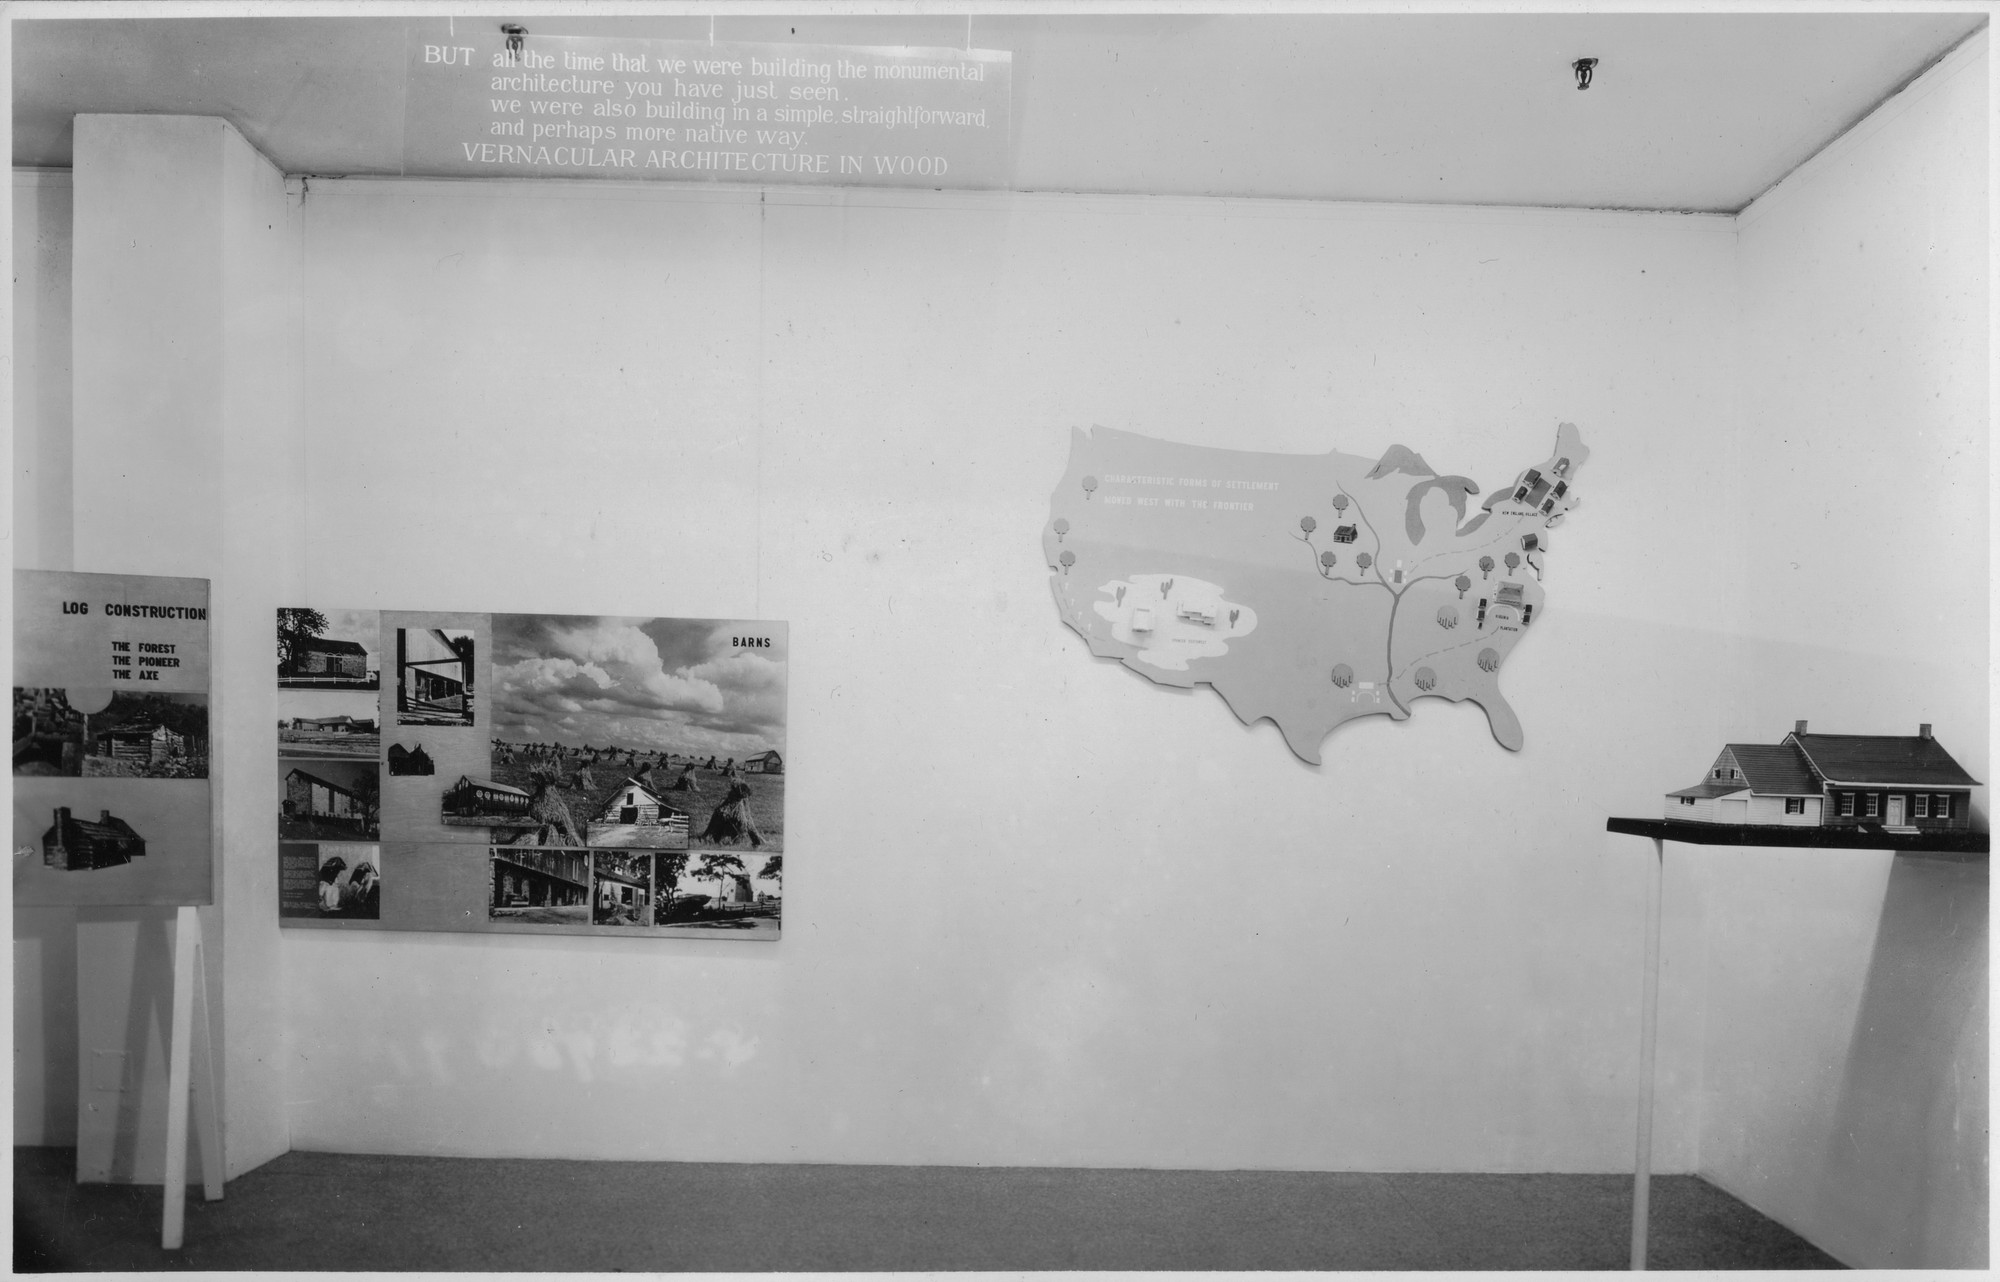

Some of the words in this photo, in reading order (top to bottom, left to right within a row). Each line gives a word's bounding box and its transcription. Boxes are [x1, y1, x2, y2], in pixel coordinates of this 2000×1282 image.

[424, 45, 475, 66] BUT
[492, 48, 516, 68] all
[523, 49, 555, 69] the
[564, 51, 605, 71] time
[612, 53, 650, 73] that
[657, 58, 687, 74] we
[692, 59, 743, 75] were
[751, 57, 831, 84] building
[837, 59, 867, 79] the
[874, 62, 984, 81] monumental
[491, 73, 615, 94] architecture
[625, 81, 662, 99] you
[674, 78, 723, 98] have
[732, 80, 778, 103] just
[789, 85, 849, 101] seen.
[491, 99, 521, 113] we
[530, 101, 583, 116] were
[593, 98, 637, 117] also
[646, 99, 726, 128] building
[733, 103, 750, 121] in
[756, 107, 768, 121] a
[774, 104, 839, 127] simple,
[841, 105, 990, 130] straightforward,
[491, 119, 524, 136] and
[533, 120, 617, 144] perhaps
[626, 126, 676, 142] more
[686, 125, 748, 143] native
[756, 129, 808, 151] way.
[462, 142, 638, 168] VERNACULAR
[645, 149, 830, 173] ARCHITECTURE
[840, 155, 863, 174] IN
[873, 155, 948, 176] WOOD
[1104, 474, 1175, 486] CHARACTERISTIC
[1179, 478, 1208, 488] FORMS
[1211, 480, 1222, 488] OF
[1225, 481, 1280, 491] SETTLEMENT
[1104, 495, 1132, 505] MOVED
[1137, 498, 1159, 507] WEST
[1164, 498, 1185, 508] WITH
[1191, 500, 1208, 509] THE
[1213, 501, 1254, 512] FRONTIER
[63, 601, 89, 615] LOG
[105, 603, 207, 620] CONSTRUCTION
[112, 641, 131, 652] THE
[138, 642, 176, 654] FOREST
[733, 636, 770, 647] BARNS
[112, 655, 131, 666] THE
[138, 657, 180, 668] PIONEER
[113, 669, 131, 680] THE
[139, 670, 159, 680] AXE
